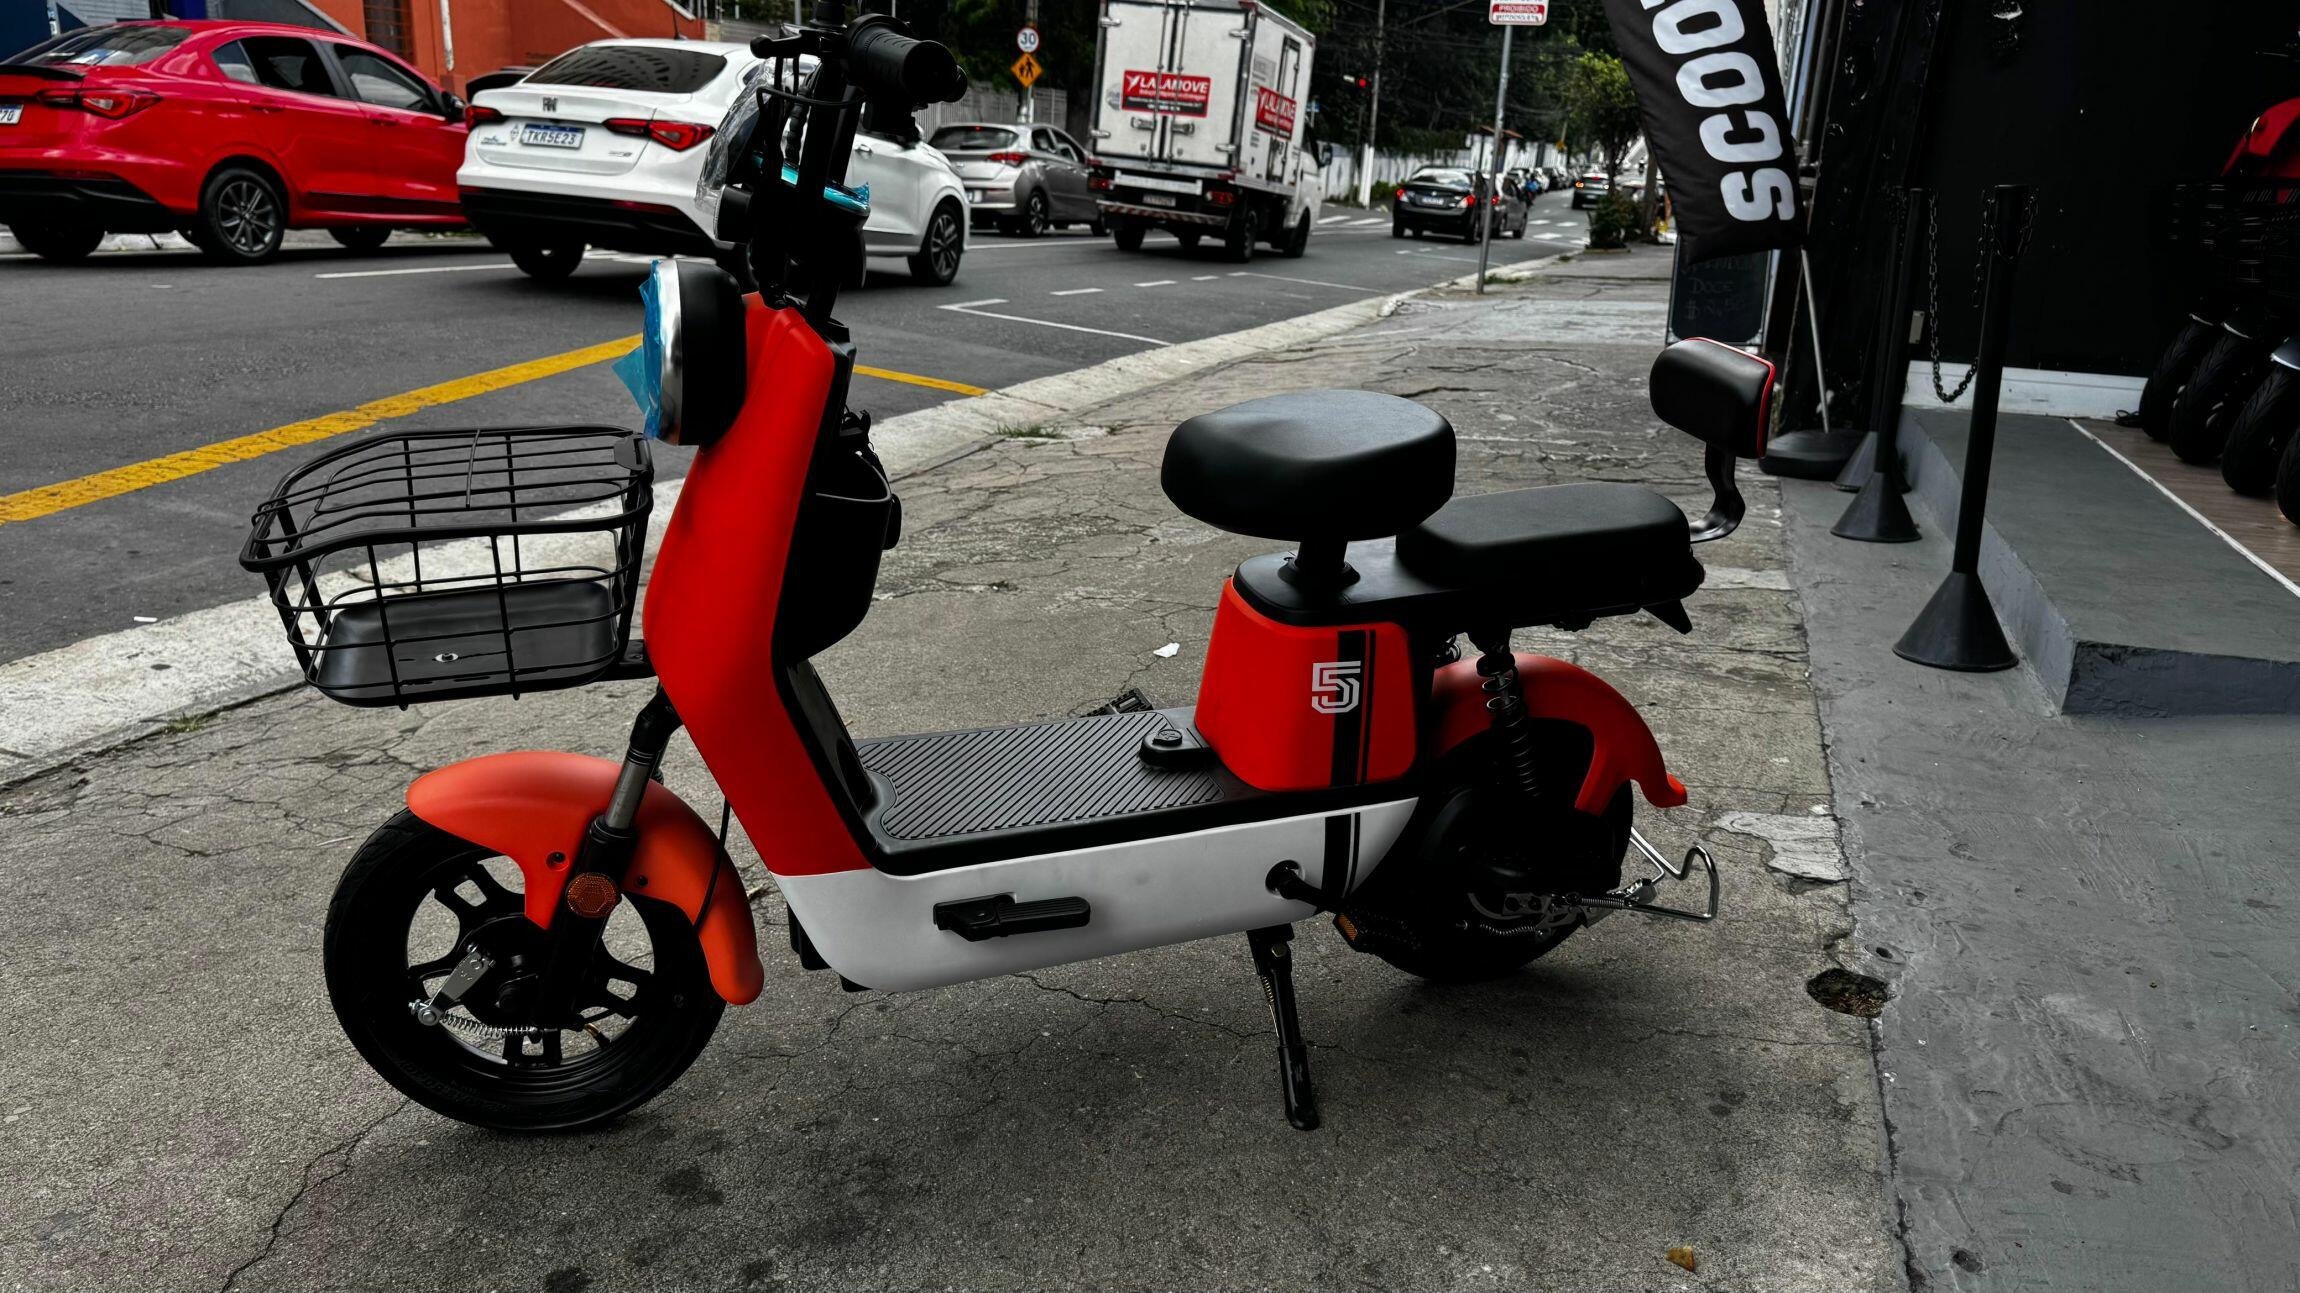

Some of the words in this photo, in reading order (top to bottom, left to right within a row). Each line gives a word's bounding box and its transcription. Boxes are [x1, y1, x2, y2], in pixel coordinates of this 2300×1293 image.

[1020, 32, 1037, 45] 30
[1640, 0, 1796, 221] SCOO
[527, 131, 577, 145] TKR5E23
